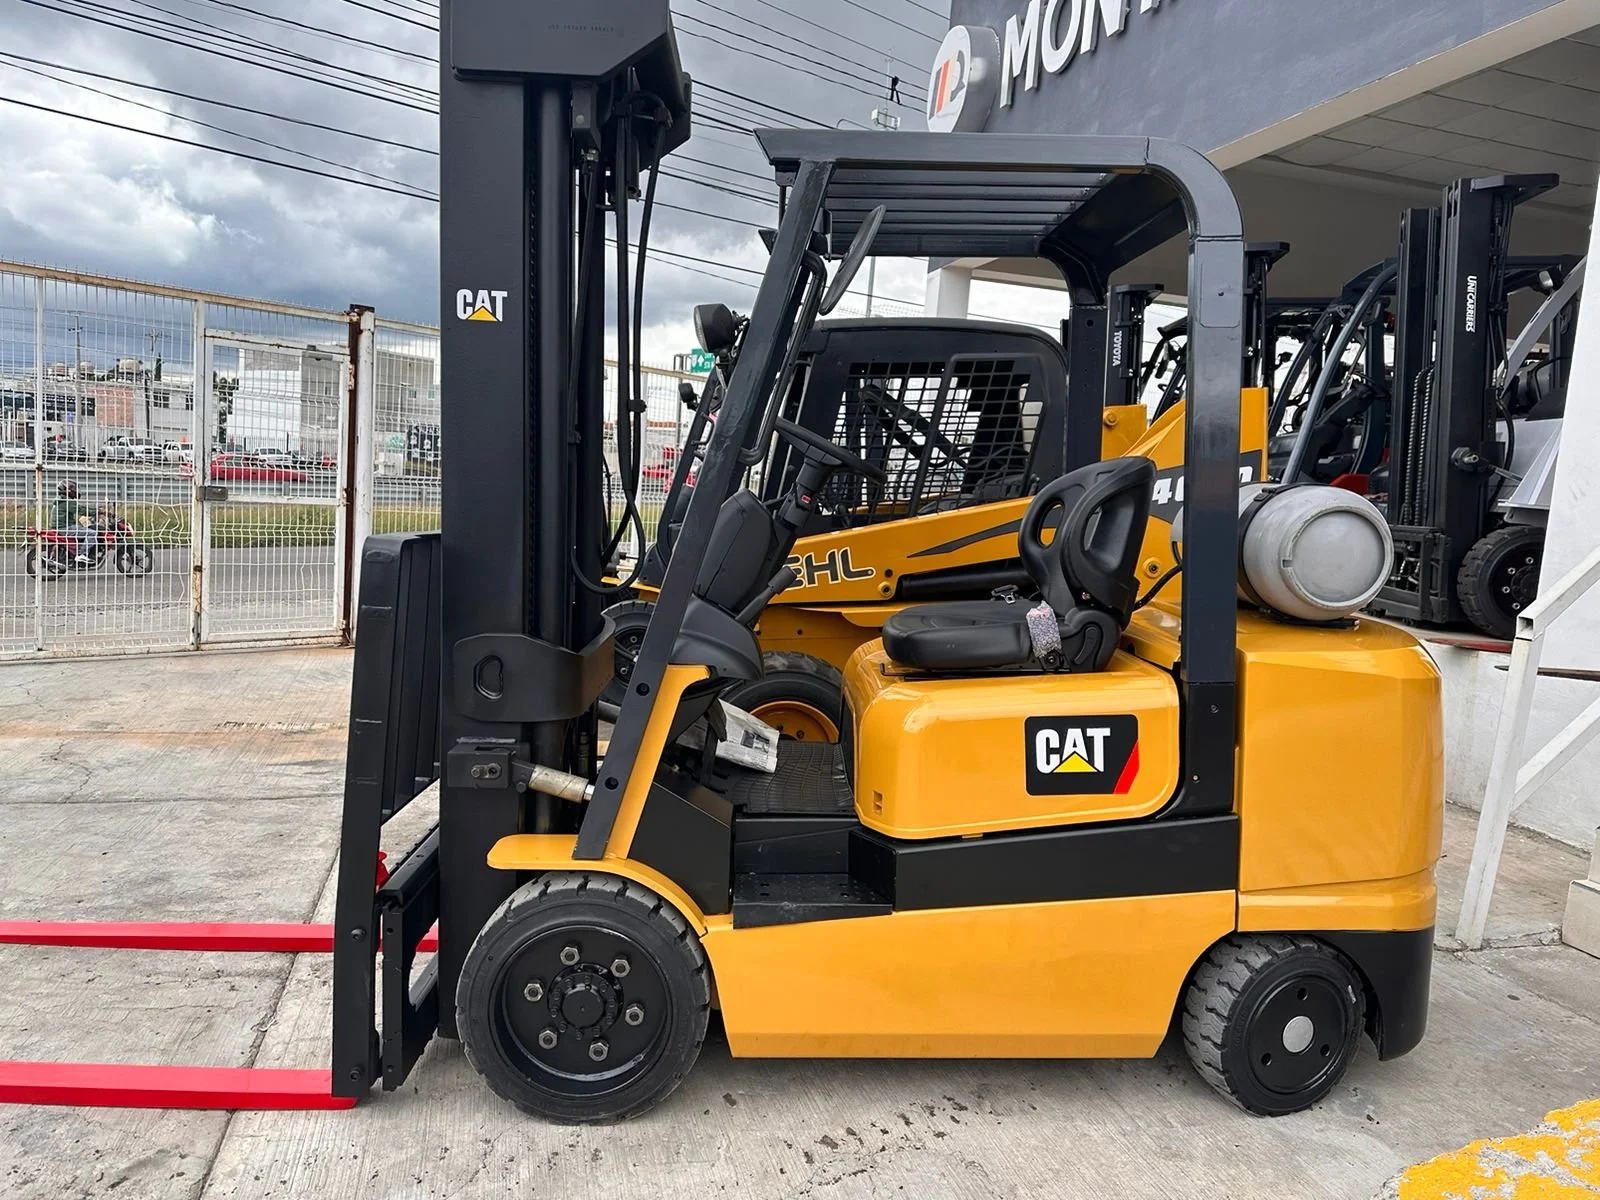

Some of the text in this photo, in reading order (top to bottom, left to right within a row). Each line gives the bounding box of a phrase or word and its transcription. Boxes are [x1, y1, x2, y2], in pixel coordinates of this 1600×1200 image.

[1000, 0, 1158, 108] MON
[456, 288, 508, 322] CAT
[1465, 275, 1478, 333] UNICARRIERS
[1112, 330, 1123, 367] TOYOTA
[1035, 727, 1111, 774] CAT
